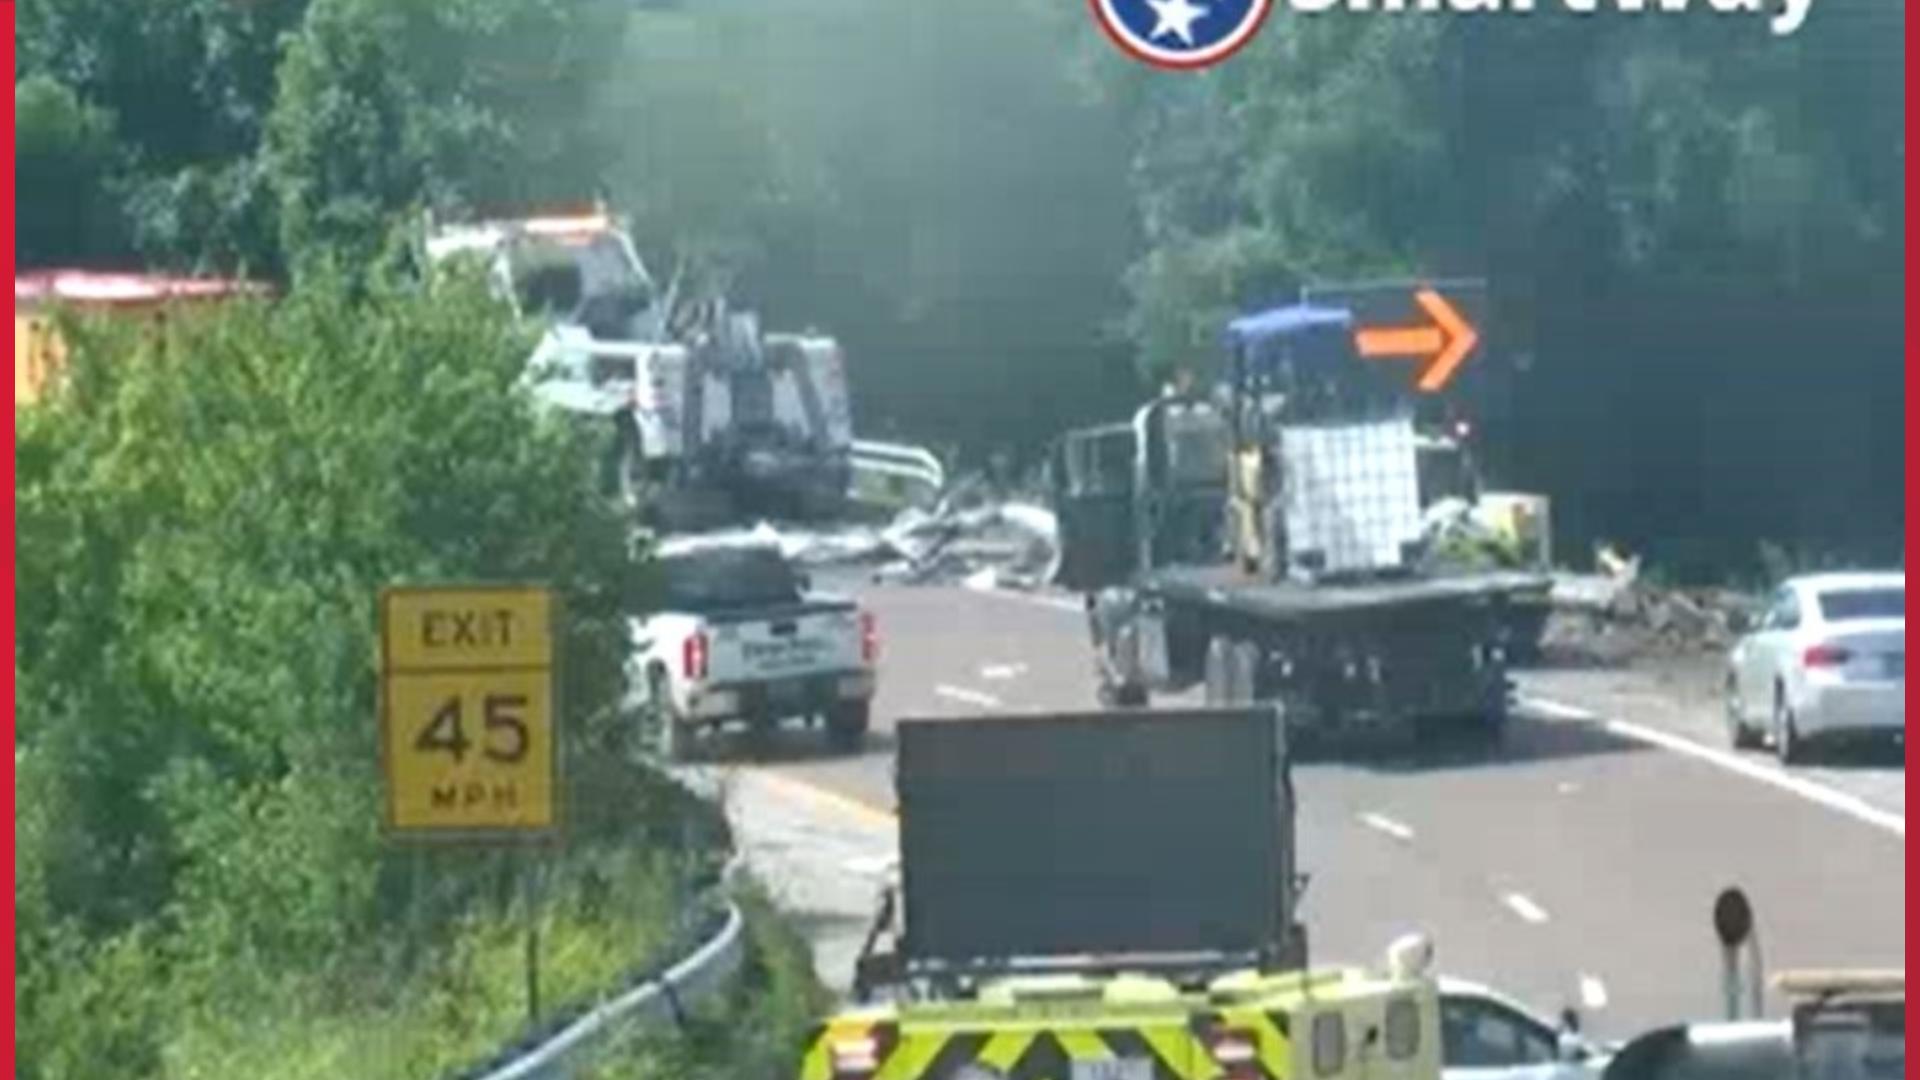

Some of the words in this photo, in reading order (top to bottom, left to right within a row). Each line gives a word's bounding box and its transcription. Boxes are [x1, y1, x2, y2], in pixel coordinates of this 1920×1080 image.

[421, 609, 514, 647] EXIT
[414, 693, 530, 764] 45
[431, 784, 518, 809] MPH
